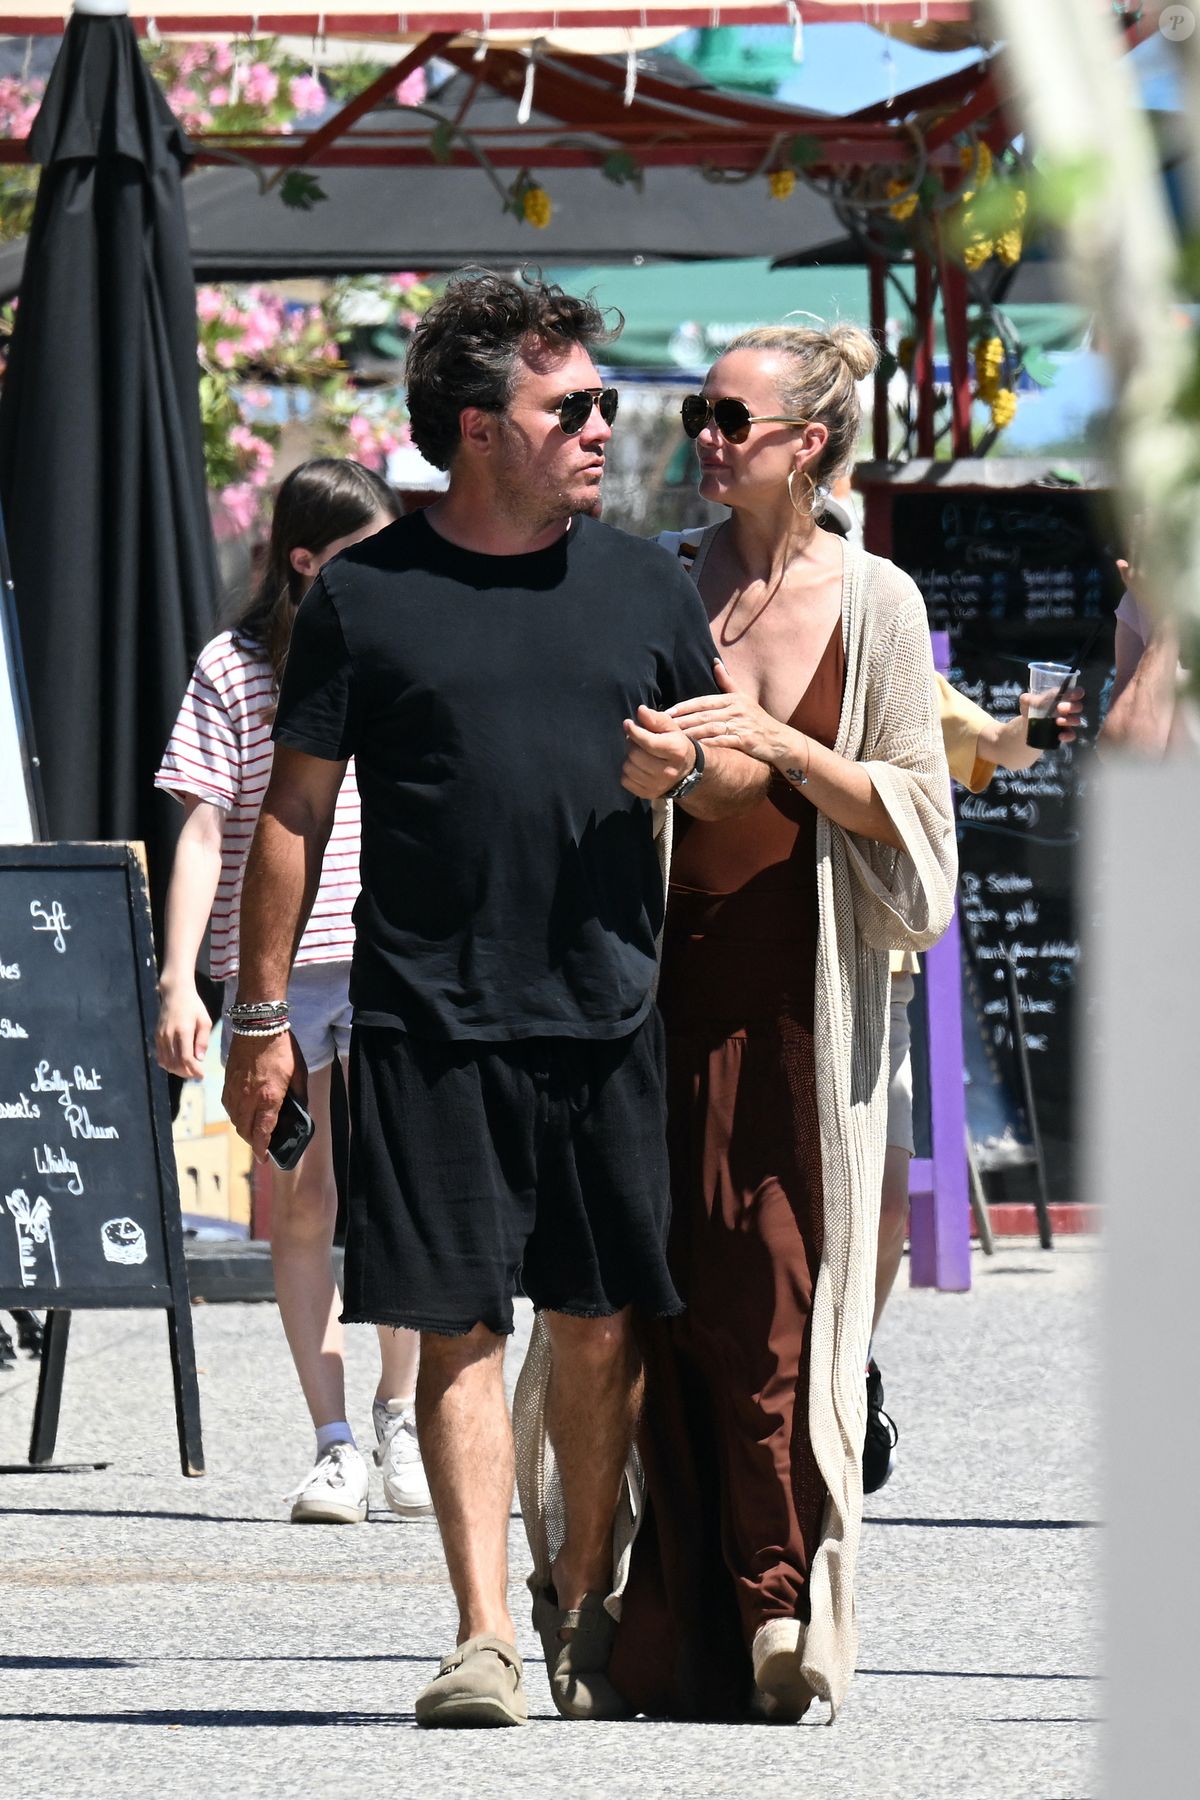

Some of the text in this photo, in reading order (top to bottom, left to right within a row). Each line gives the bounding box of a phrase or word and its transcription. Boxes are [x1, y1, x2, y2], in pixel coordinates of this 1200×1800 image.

[30, 899, 72, 954] Soft
[64, 1103, 120, 1140] Rhum
[33, 1143, 84, 1197] Whisky
